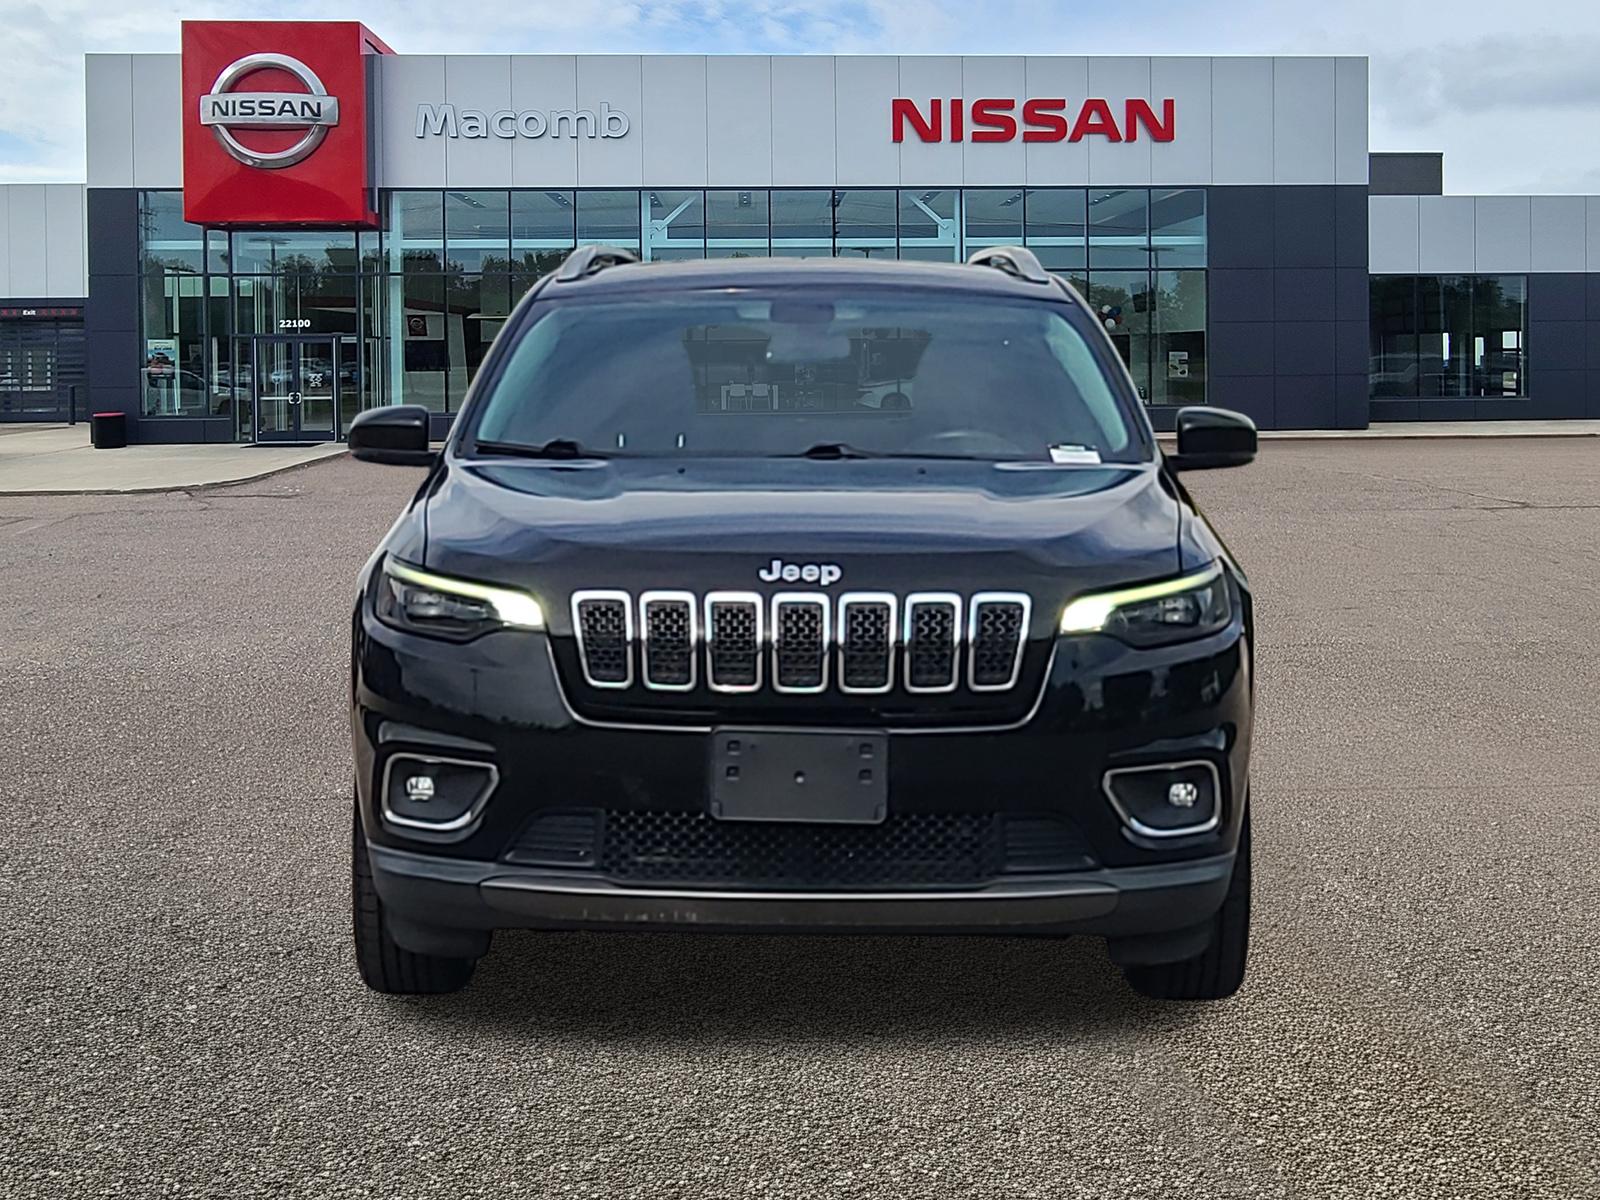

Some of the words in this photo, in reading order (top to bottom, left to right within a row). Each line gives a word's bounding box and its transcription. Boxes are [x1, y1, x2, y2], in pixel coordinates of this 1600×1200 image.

[211, 100, 322, 118] NISSAN
[415, 102, 630, 139] Macomb
[891, 98, 1175, 142] NISSAN
[279, 319, 311, 328] 22100
[758, 560, 842, 585] Jeep
